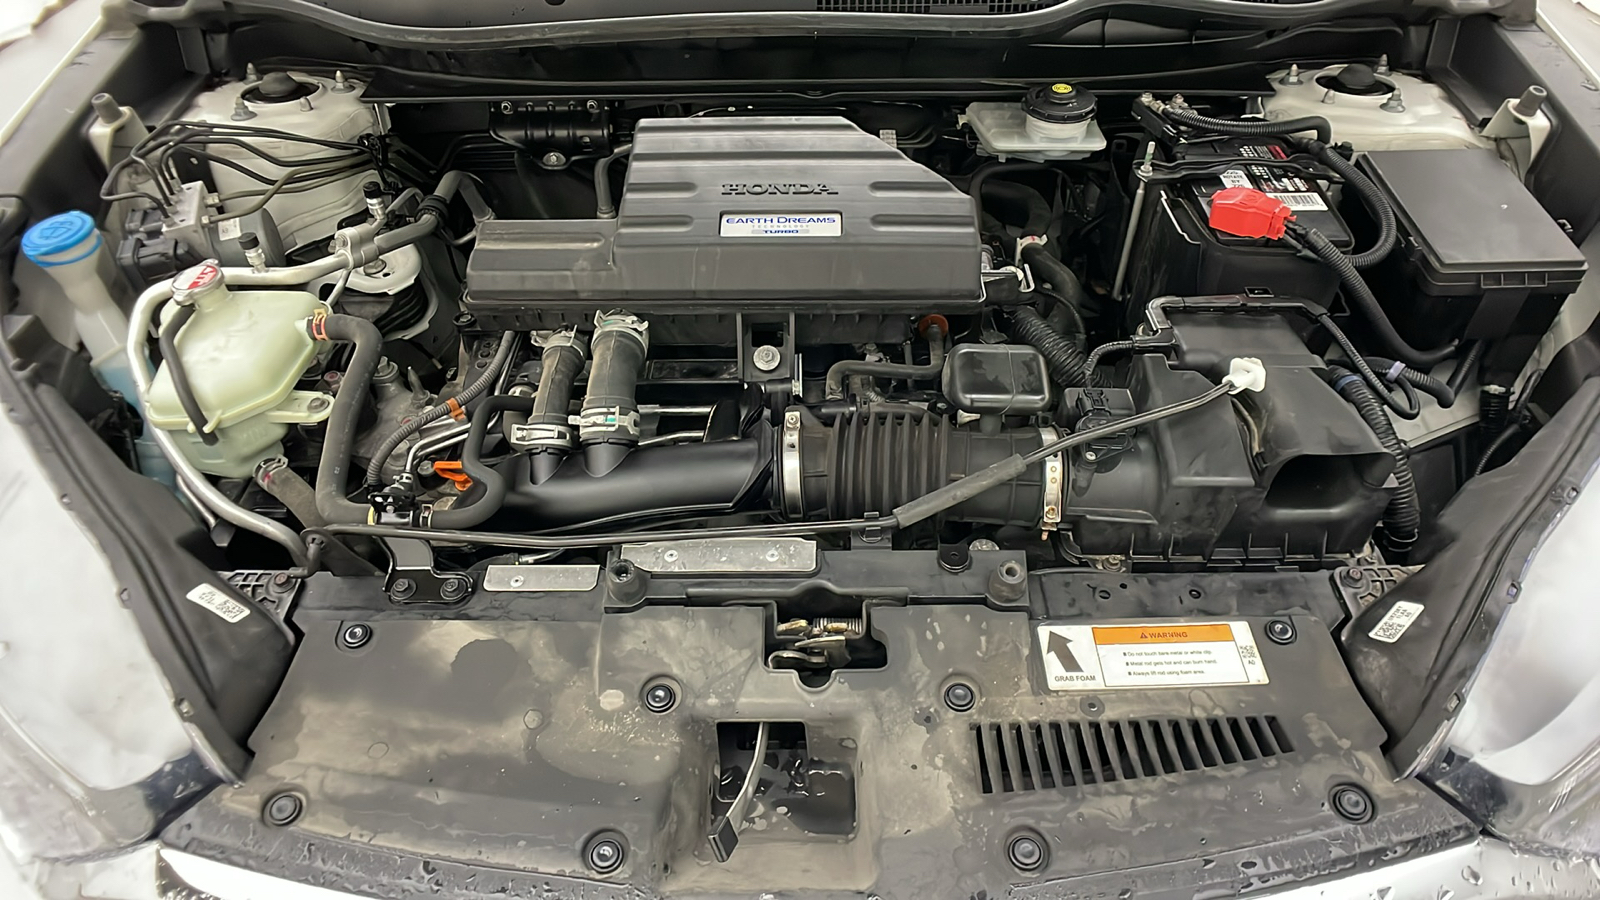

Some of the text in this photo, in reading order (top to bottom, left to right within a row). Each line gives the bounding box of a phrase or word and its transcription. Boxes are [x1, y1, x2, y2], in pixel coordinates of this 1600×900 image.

[721, 183, 839, 195] HONDA
[777, 216, 836, 224] DREAMS
[1149, 631, 1188, 639] WARNING
